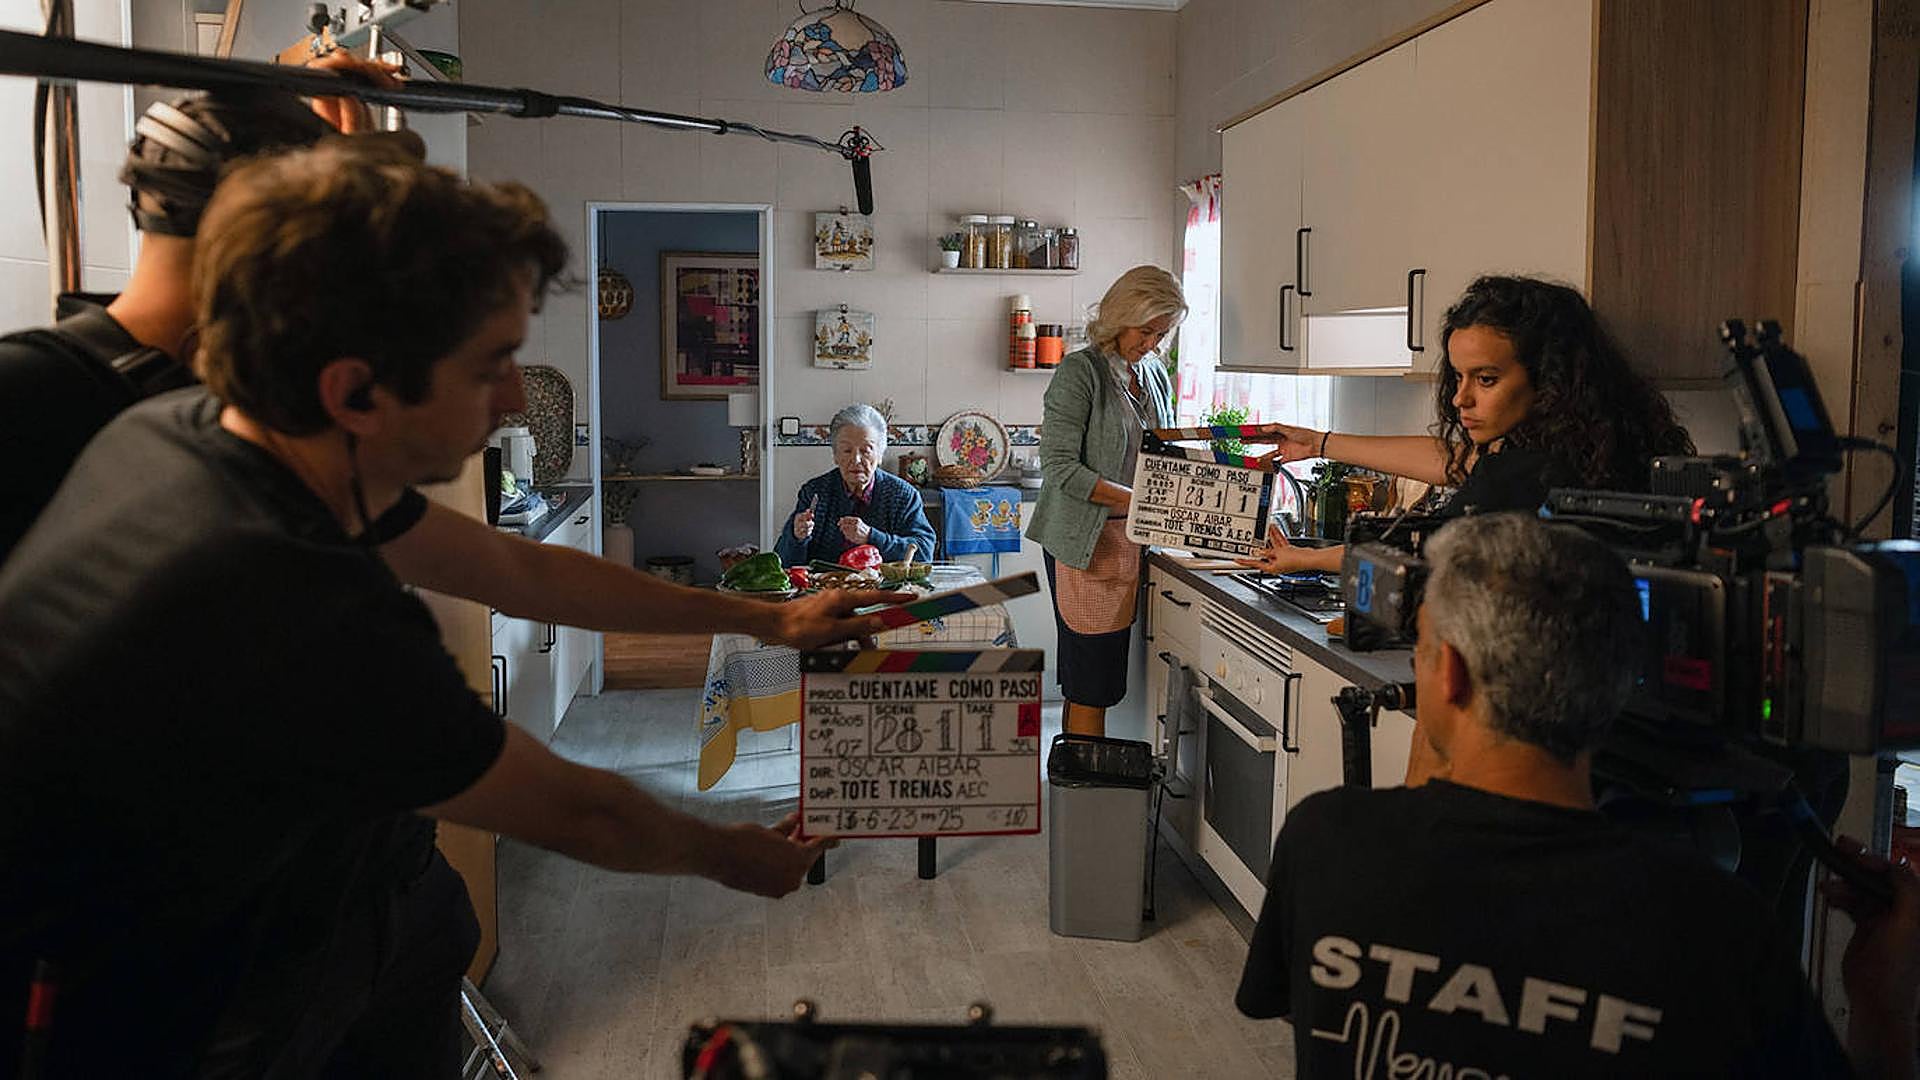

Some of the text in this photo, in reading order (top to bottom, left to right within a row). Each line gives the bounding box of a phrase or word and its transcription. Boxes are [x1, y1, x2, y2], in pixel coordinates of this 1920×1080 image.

[1241, 495, 1247, 512] 1
[1170, 508, 1200, 522] OSCAR
[1204, 514, 1232, 527] AIBAR
[1164, 518, 1184, 532] TOTE
[1190, 522, 1223, 537] TRENAS
[849, 681, 938, 699] CUENTAME
[949, 680, 994, 698] COMO
[1000, 680, 1038, 698] PASO
[809, 706, 841, 715] ROLL
[875, 704, 915, 715] SCENE
[966, 703, 994, 714] TAKE
[976, 714, 996, 751] 1
[838, 759, 906, 778] OSCAR
[917, 758, 982, 777] AIBAR
[840, 780, 880, 799] TOTE
[889, 780, 953, 799] TRENAS
[956, 781, 989, 798] AEC
[1310, 936, 1663, 1054] STAFF
